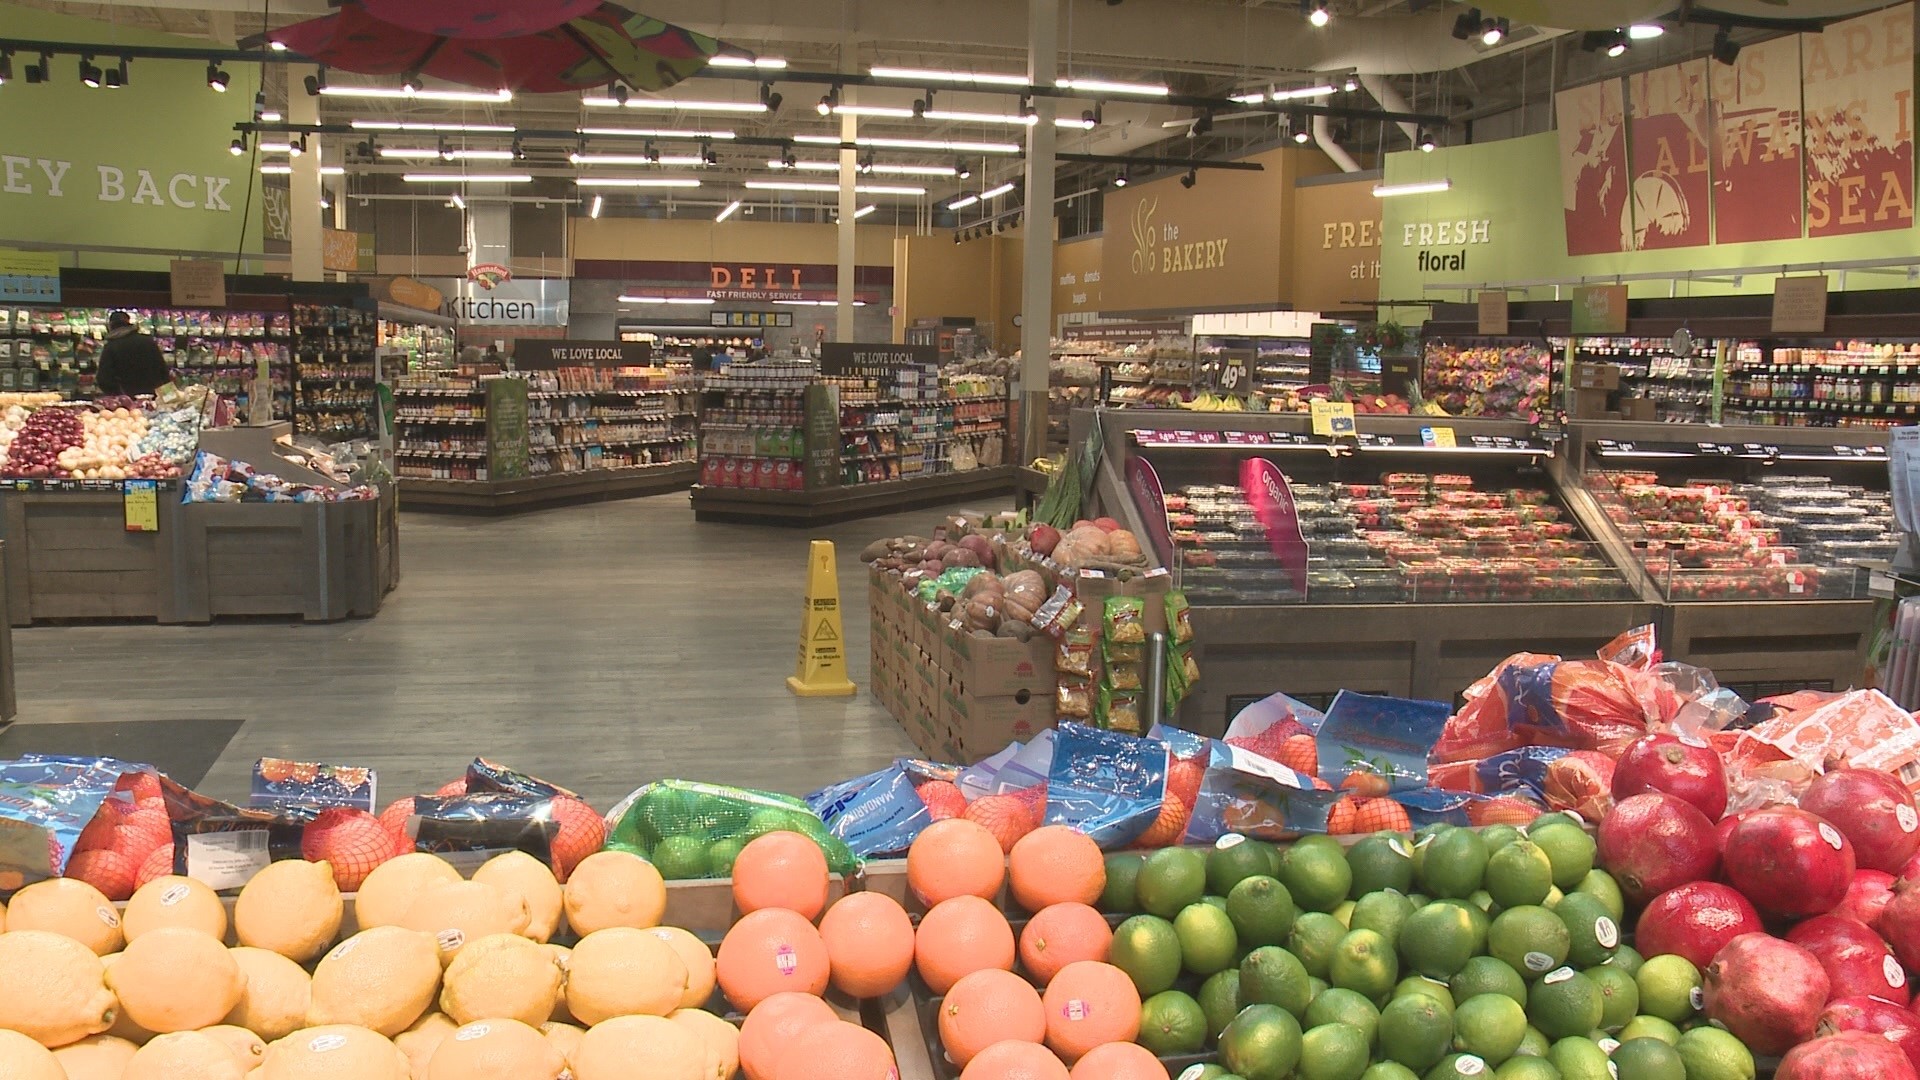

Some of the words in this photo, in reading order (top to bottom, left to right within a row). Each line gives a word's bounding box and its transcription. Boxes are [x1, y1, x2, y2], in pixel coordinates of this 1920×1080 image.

[1804, 10, 1912, 84] ARE
[1651, 99, 1871, 176] ALWAYS
[2, 155, 71, 197] EY
[97, 165, 231, 212] BACK
[1807, 171, 1912, 229] SEA
[1163, 223, 1178, 241] the
[1402, 220, 1491, 247] FRESH
[1162, 238, 1229, 274] BAKERY
[1418, 250, 1466, 271] floral
[471, 265, 508, 279] Hannaford
[711, 267, 801, 290] DELI
[1350, 262, 1365, 279] at
[707, 290, 727, 298] FAST
[728, 291, 766, 299] FRIENDLY
[769, 292, 803, 300] SERVICE
[446, 296, 535, 319] Kitchen
[552, 348, 567, 359] WE
[569, 348, 594, 360] LOVE
[595, 348, 622, 360] LOCAL
[853, 352, 866, 363] WE
[868, 352, 889, 363] LOVE
[890, 353, 915, 364] LOCAL
[1262, 470, 1289, 515] organic
